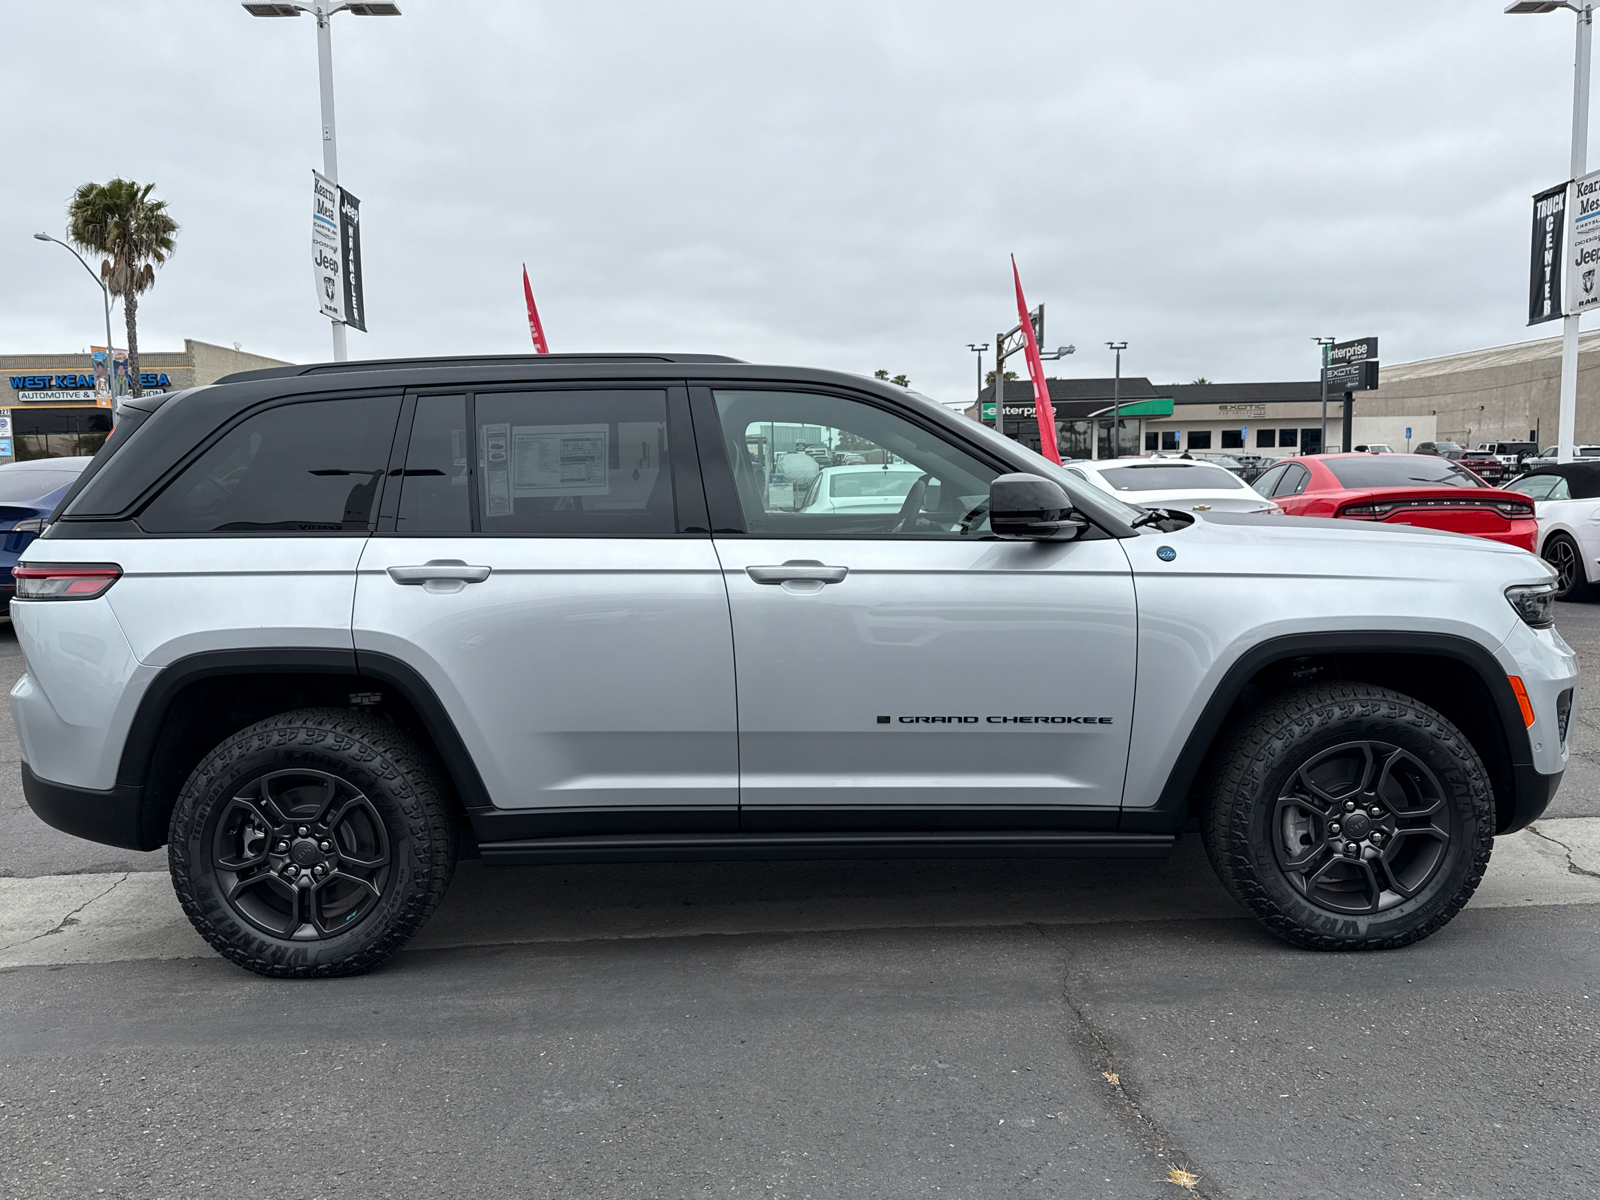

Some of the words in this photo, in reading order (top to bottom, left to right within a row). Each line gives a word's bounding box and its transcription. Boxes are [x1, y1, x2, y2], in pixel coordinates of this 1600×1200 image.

[314, 178, 336, 208] Kearny
[1576, 180, 1600, 199] Kear
[317, 198, 335, 221] Mesa
[341, 198, 359, 225] Jeep
[1536, 192, 1565, 219] TRUCK
[1579, 197, 1600, 215] Mes
[1575, 219, 1600, 230] CHRYSL
[314, 249, 339, 276] Jeep
[347, 225, 359, 321] WRANGLER
[1543, 216, 1554, 317] CENTER
[1578, 297, 1598, 307] RAM
[9, 375, 53, 389] WEST
[1327, 365, 1360, 378] EXOTIC
[21, 391, 81, 400] AUTOMOTIVE
[83, 391, 91, 399] &
[987, 406, 1057, 417] eterpre
[898, 716, 979, 724] GRAND
[986, 716, 1113, 725] CHEROKEE
[1255, 847, 1360, 935] WRANGLER
[195, 883, 310, 966] WRANGLER
